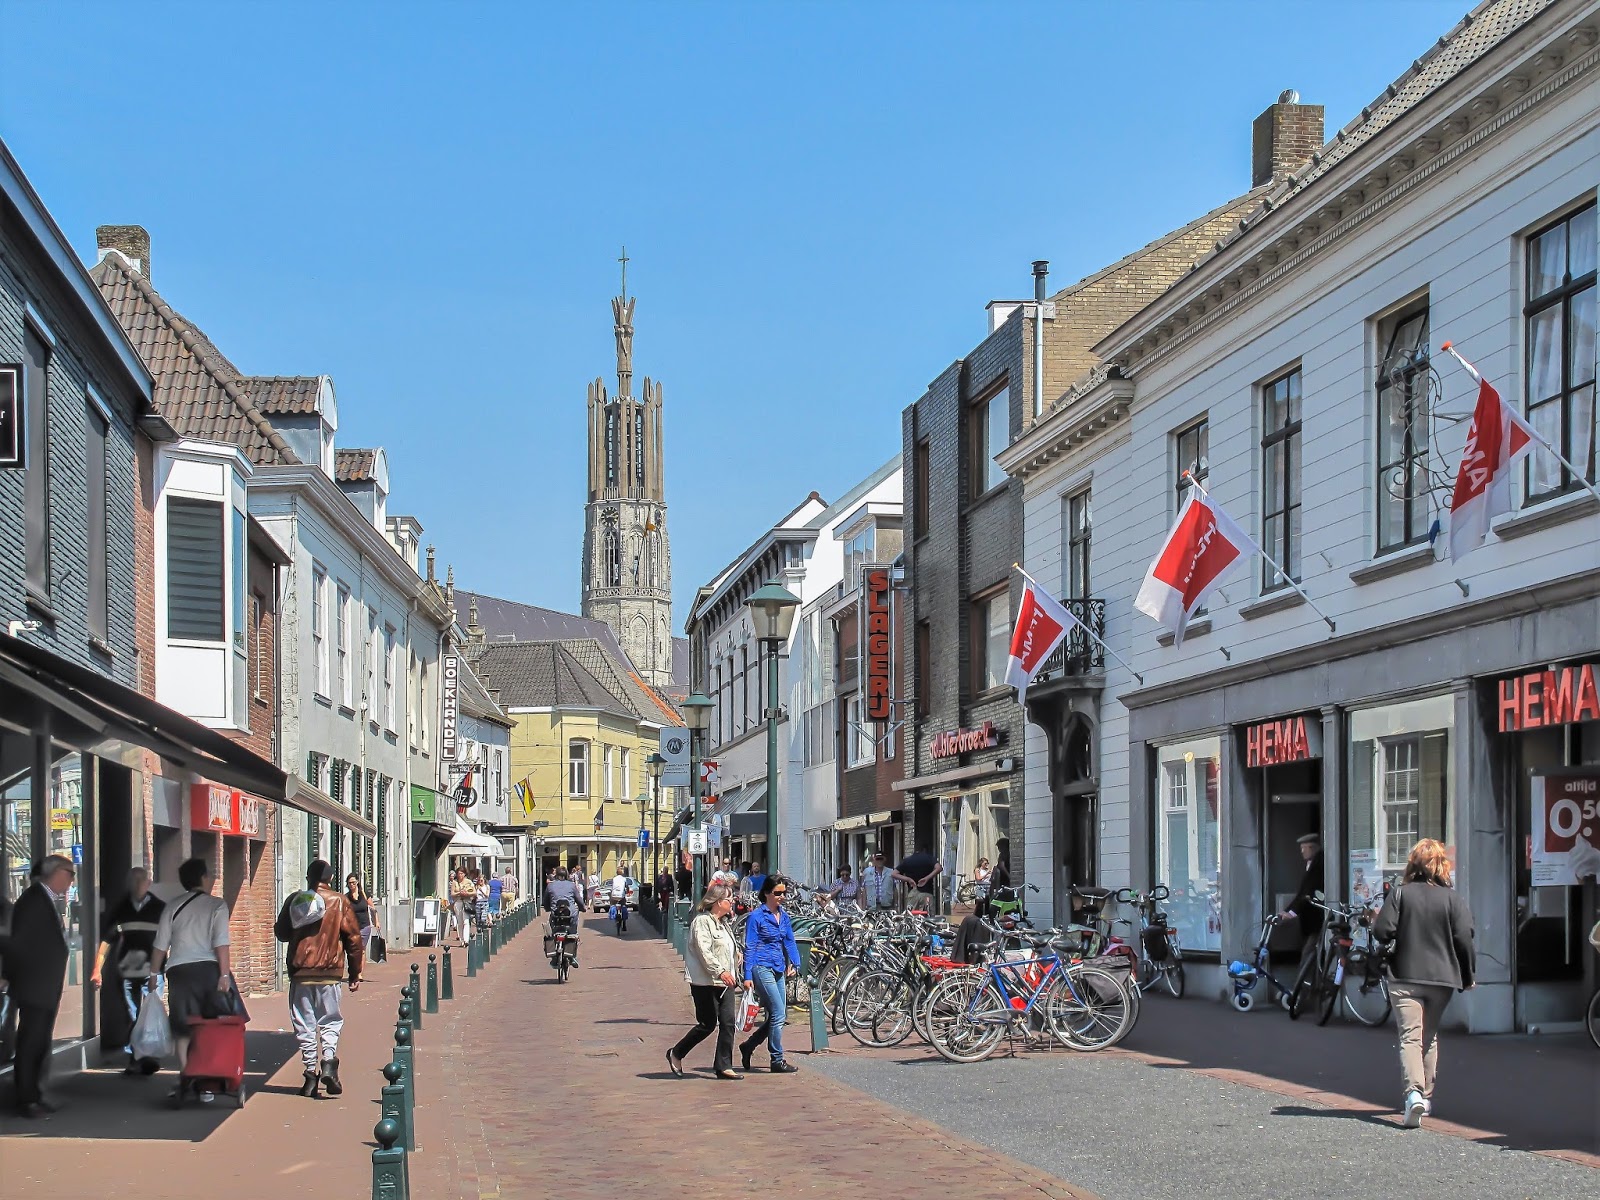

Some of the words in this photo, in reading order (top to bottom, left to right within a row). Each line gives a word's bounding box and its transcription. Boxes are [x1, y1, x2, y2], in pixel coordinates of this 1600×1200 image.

[869, 571, 889, 718] SLAGERIJ
[444, 658, 457, 759] BOEKHANDEL
[1498, 663, 1600, 733] HEMA
[1247, 716, 1310, 768] HEMA
[1565, 780, 1597, 794] altijd
